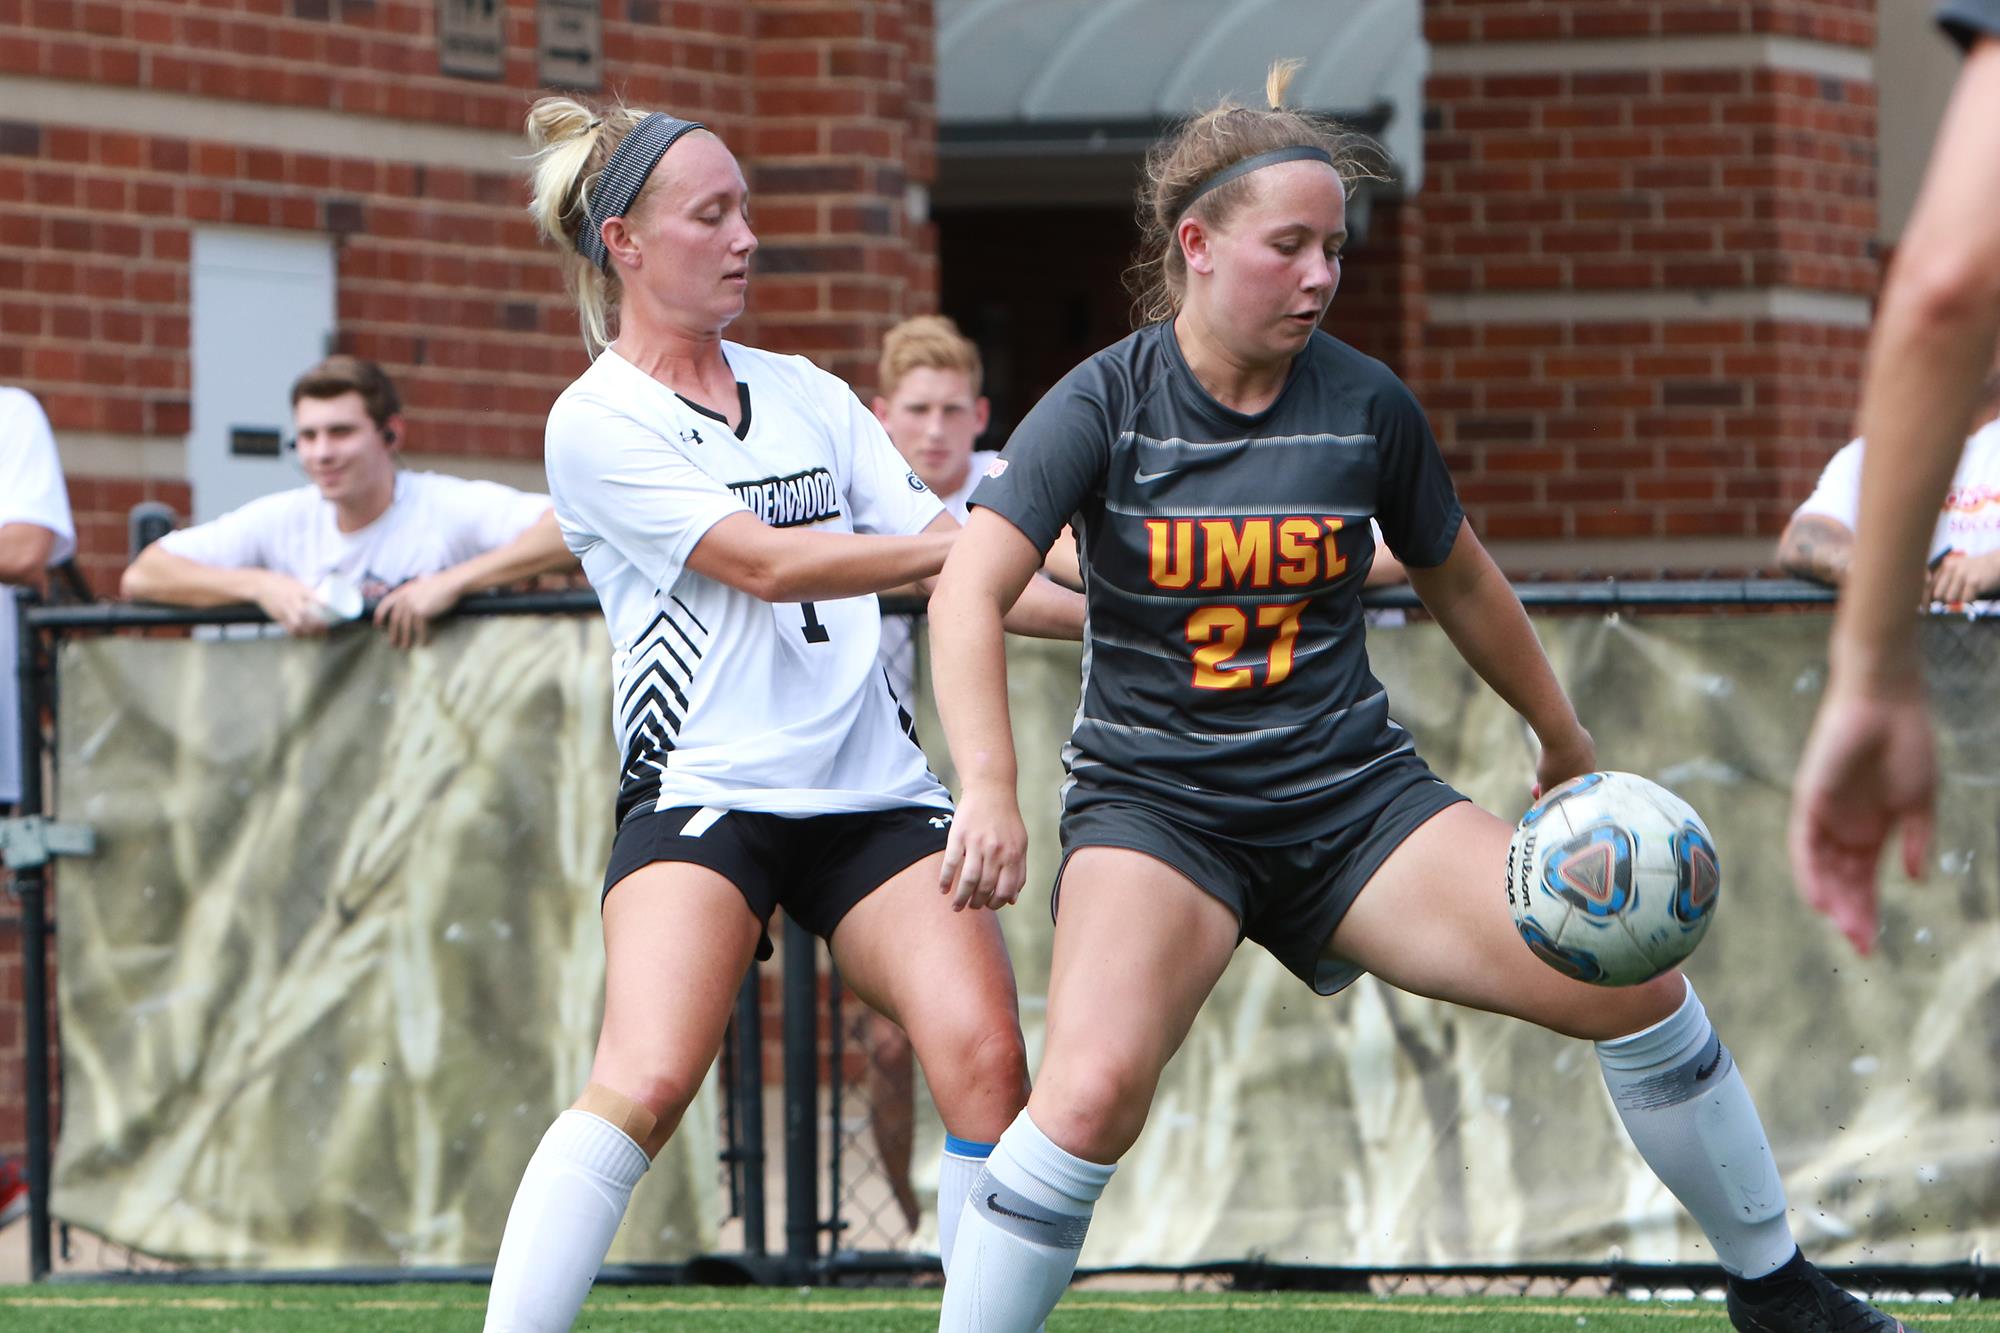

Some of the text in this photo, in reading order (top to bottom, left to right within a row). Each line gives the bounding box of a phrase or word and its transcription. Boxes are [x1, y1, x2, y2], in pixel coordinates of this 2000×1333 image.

[727, 468, 841, 527] NDENWOOD
[1144, 517, 1348, 589] UMSL
[1185, 598, 1312, 689] 27
[1522, 835, 1537, 909] Wilson
